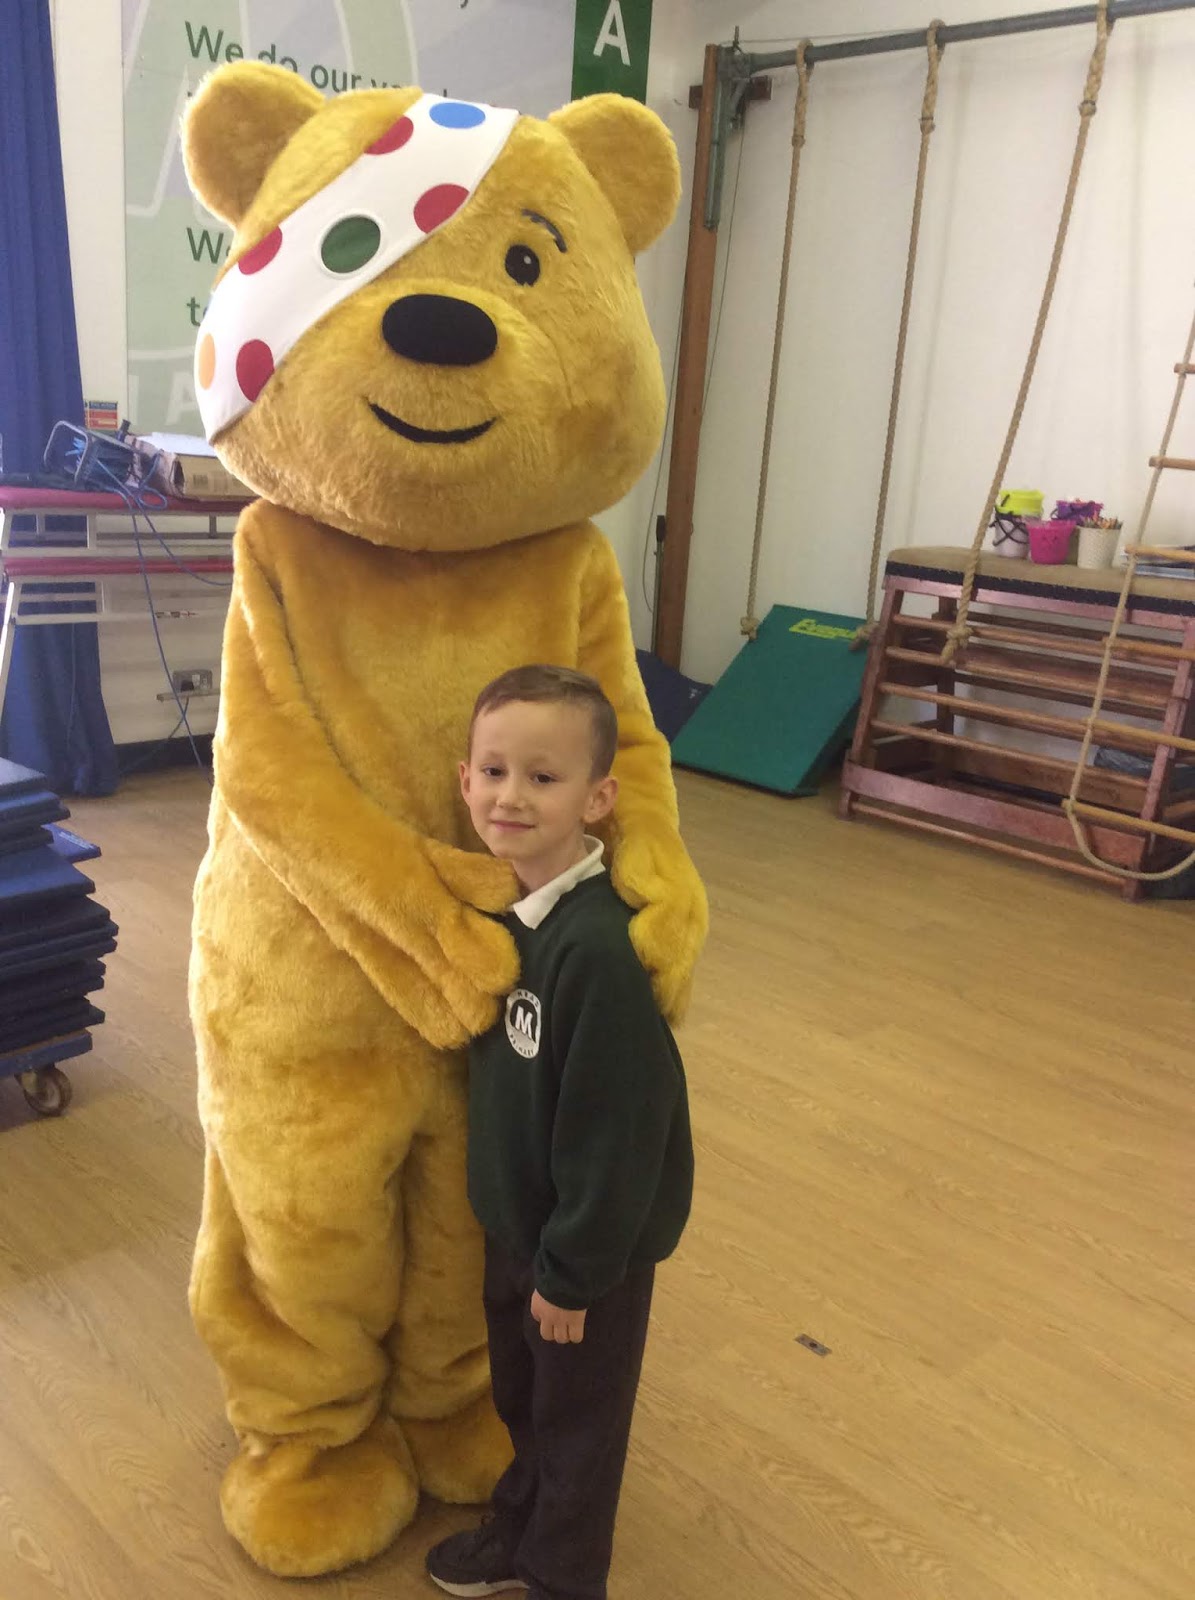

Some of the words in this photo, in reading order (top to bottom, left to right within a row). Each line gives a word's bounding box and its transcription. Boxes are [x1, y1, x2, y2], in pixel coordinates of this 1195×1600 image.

[185, 20, 244, 63] We
[310, 64, 362, 93] our
[593, 0, 632, 67] A
[186, 226, 233, 264] W
[514, 1005, 533, 1041] M
